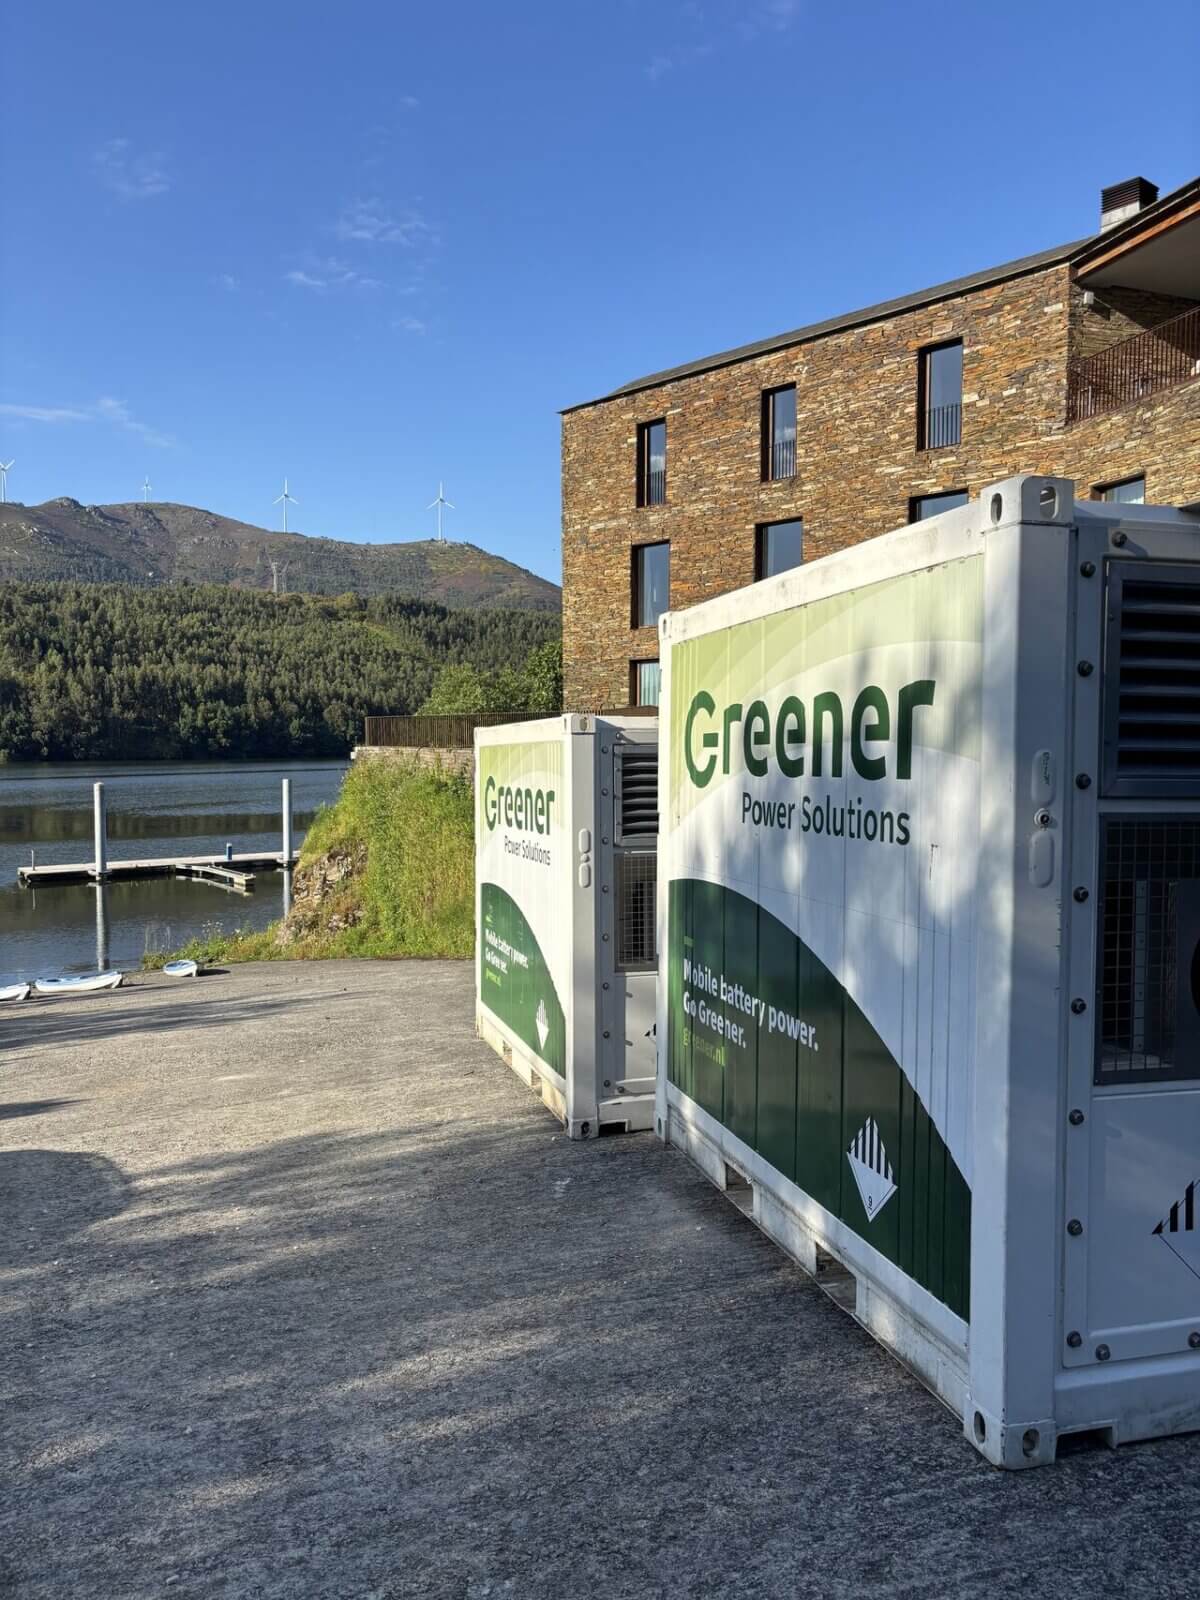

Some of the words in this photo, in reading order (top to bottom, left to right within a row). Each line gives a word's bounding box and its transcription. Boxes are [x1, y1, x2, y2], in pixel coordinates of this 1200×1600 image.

[685, 680, 936, 788] Greener
[485, 775, 555, 836] Greener
[742, 791, 796, 829] Power
[801, 795, 911, 845] Solutions
[683, 958, 718, 997] Mobile
[720, 974, 766, 1027] battery
[768, 1005, 819, 1051] power.
[683, 991, 697, 1017] Go
[698, 999, 746, 1049] Greener.
